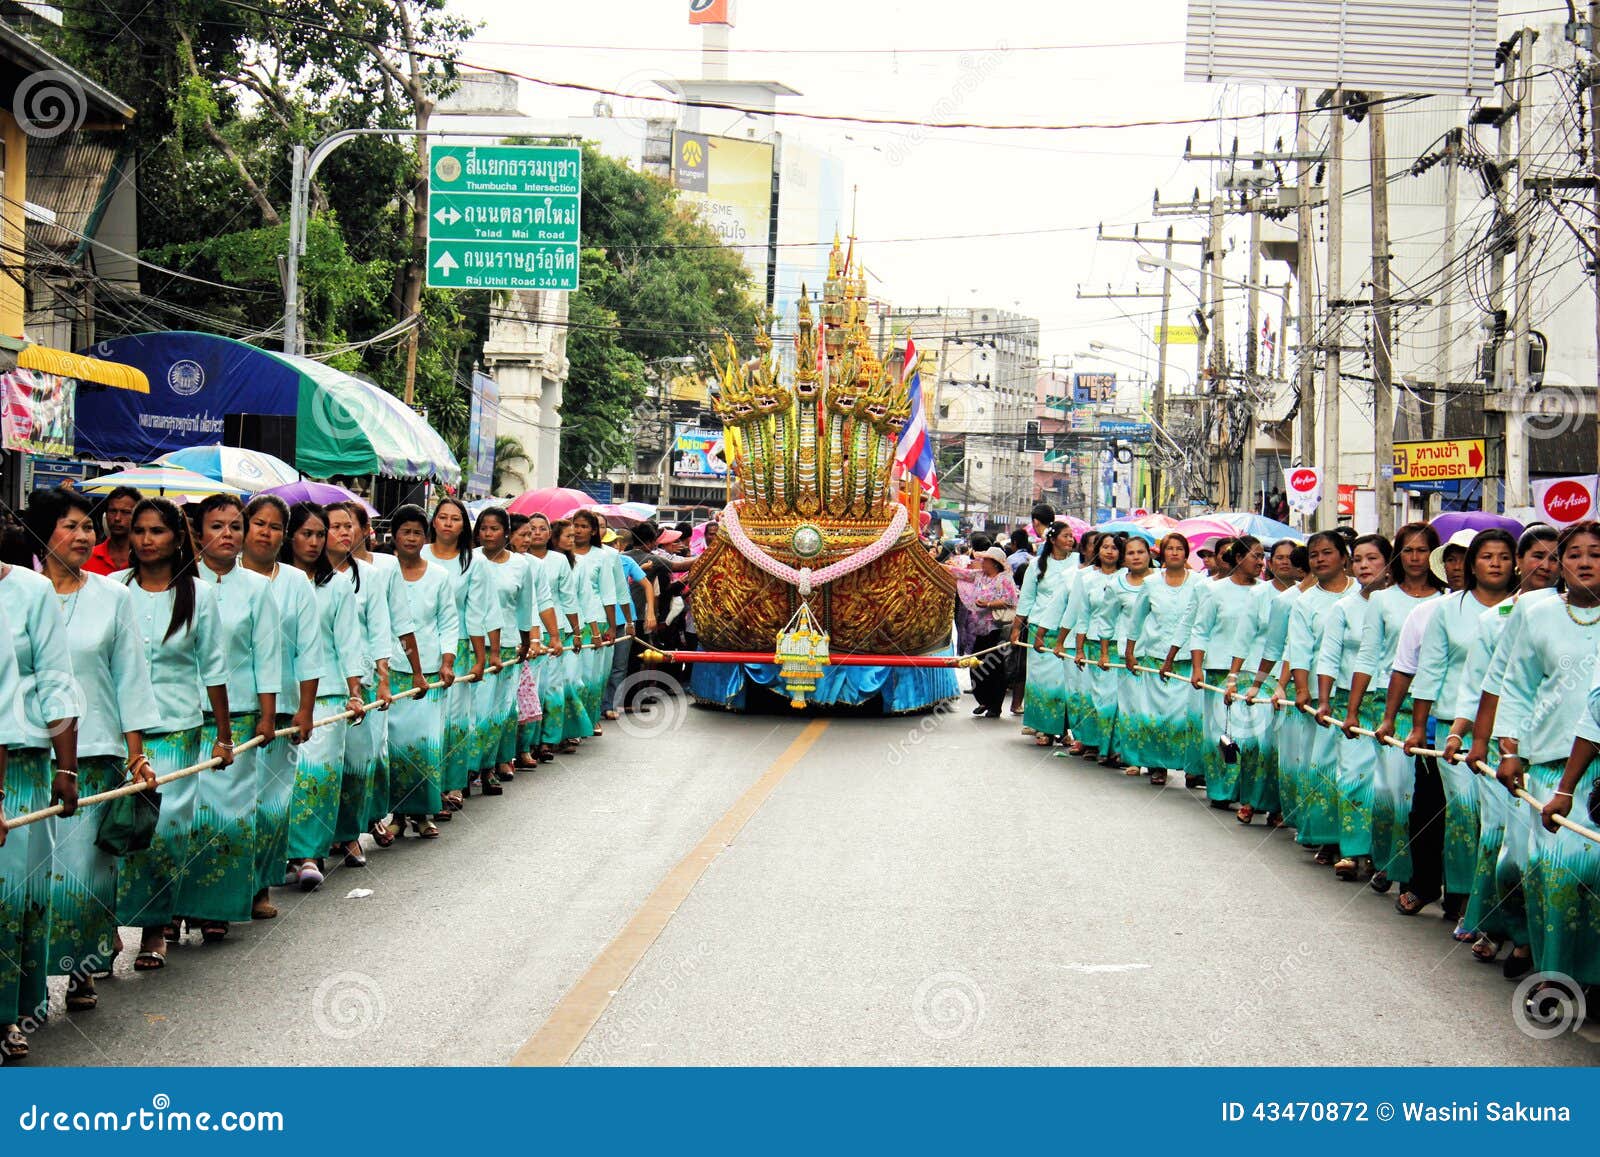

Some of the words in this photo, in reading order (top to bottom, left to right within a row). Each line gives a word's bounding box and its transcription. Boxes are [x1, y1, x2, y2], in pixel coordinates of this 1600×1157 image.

[465, 147, 577, 183] สี่แยกธรรมบูชา
[466, 181, 517, 191] Thumbucha
[525, 183, 576, 193] Intersection
[464, 197, 576, 225] ถนนตลาดใหม่
[713, 203, 732, 215] SME
[475, 228, 502, 238] Talad
[512, 229, 529, 239] Mai
[538, 230, 565, 239] Road
[466, 276, 482, 287] Raj
[485, 276, 508, 285] Uthit
[511, 277, 536, 286] Road
[538, 277, 557, 286] 340
[560, 277, 571, 287] M.
[1416, 441, 1459, 459] ทางเข้า
[47, 464, 73, 472] TOT
[1410, 460, 1467, 477] ที่จอดรถ
